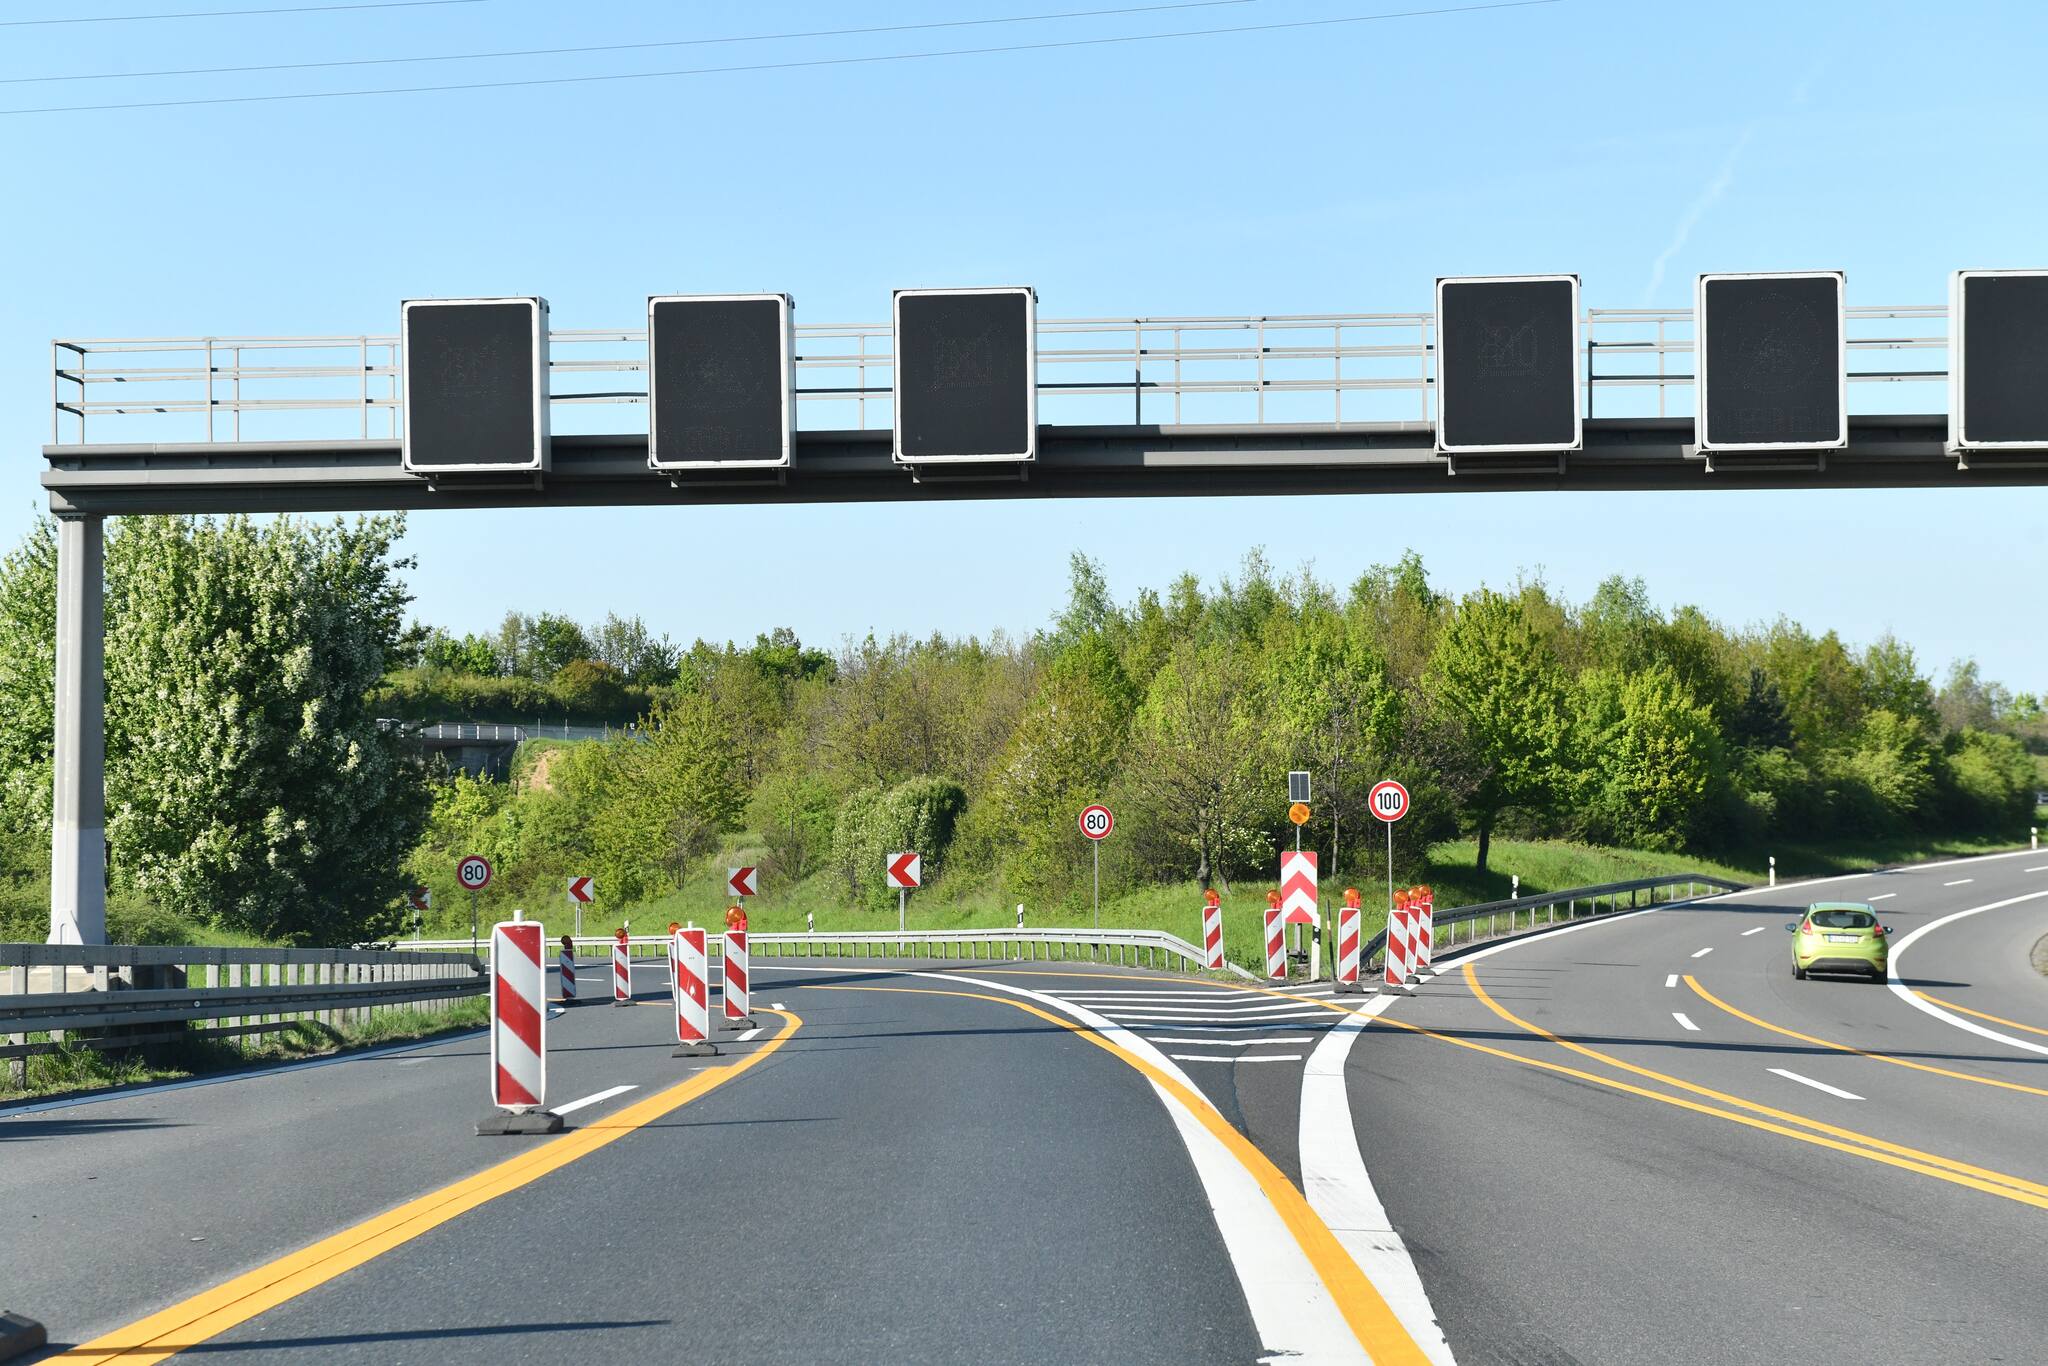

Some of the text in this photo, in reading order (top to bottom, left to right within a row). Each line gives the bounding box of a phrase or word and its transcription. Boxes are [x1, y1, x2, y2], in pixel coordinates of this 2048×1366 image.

[1377, 792, 1401, 810] 100
[1087, 814, 1106, 830] 80
[464, 865, 484, 881] 80
